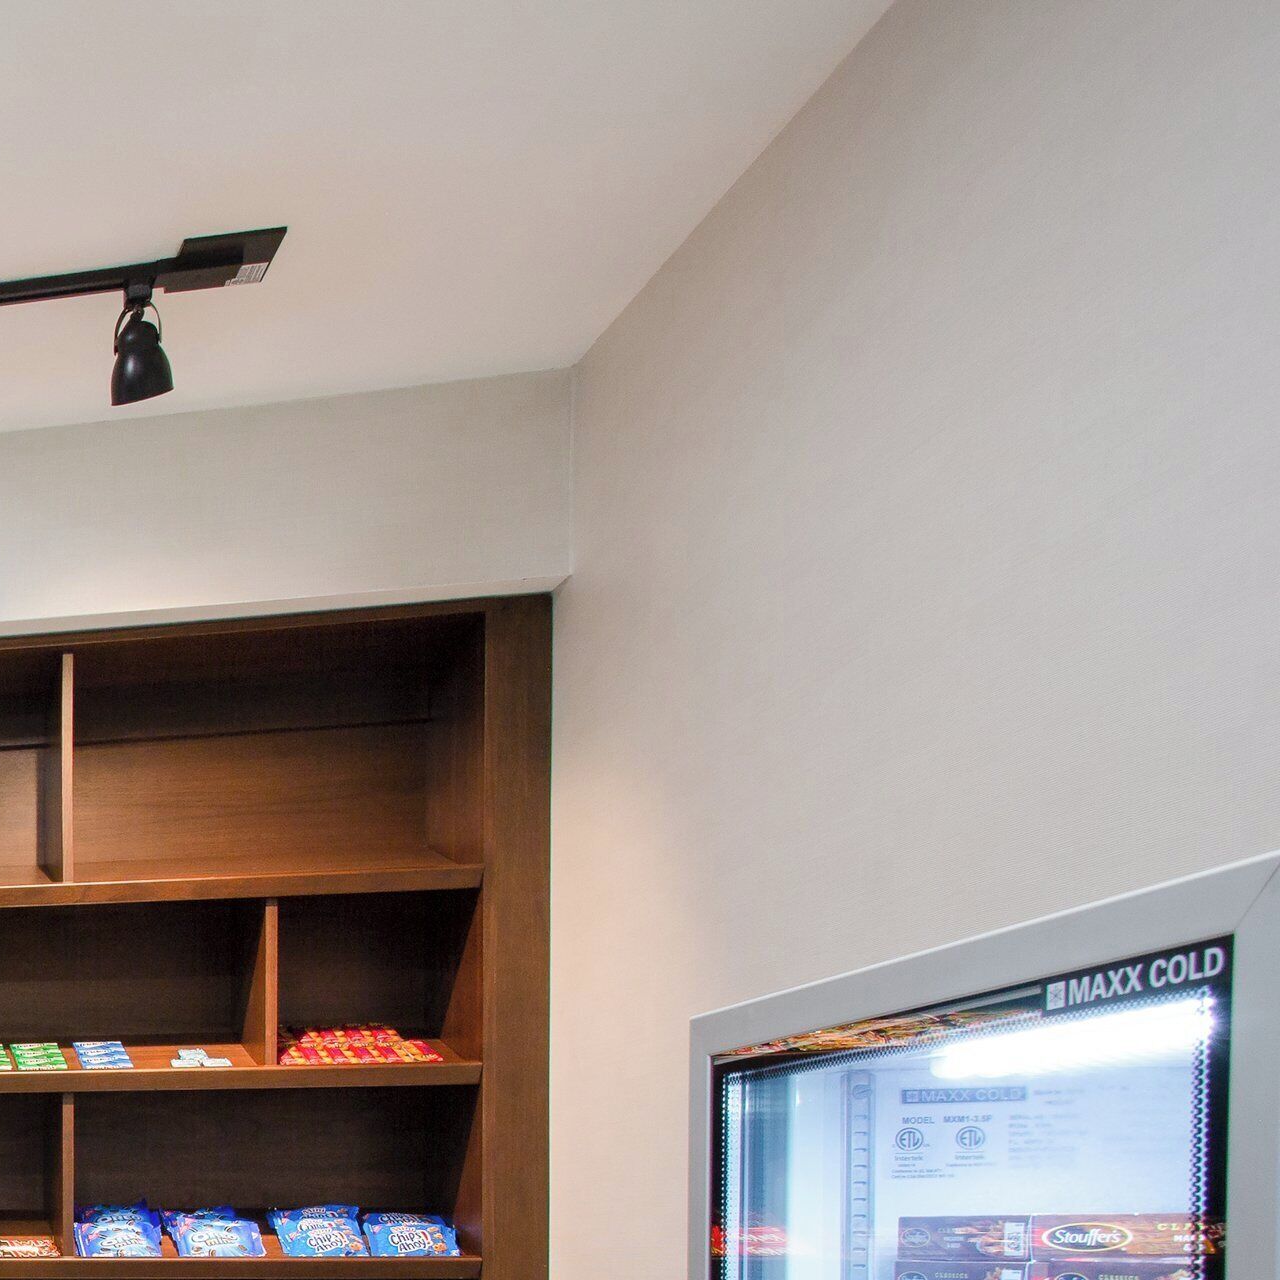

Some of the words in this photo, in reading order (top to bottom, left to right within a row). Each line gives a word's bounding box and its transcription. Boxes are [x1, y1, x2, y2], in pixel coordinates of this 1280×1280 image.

[1068, 962, 1144, 1006] MAXX
[1149, 946, 1226, 989] COLD
[921, 1089, 972, 1102] MAXX
[975, 1087, 1023, 1101] COLD
[902, 1116, 935, 1125] MODEL
[308, 1232, 340, 1247] Chips
[390, 1230, 423, 1247] Chips
[1053, 1227, 1122, 1246] Stouffer's
